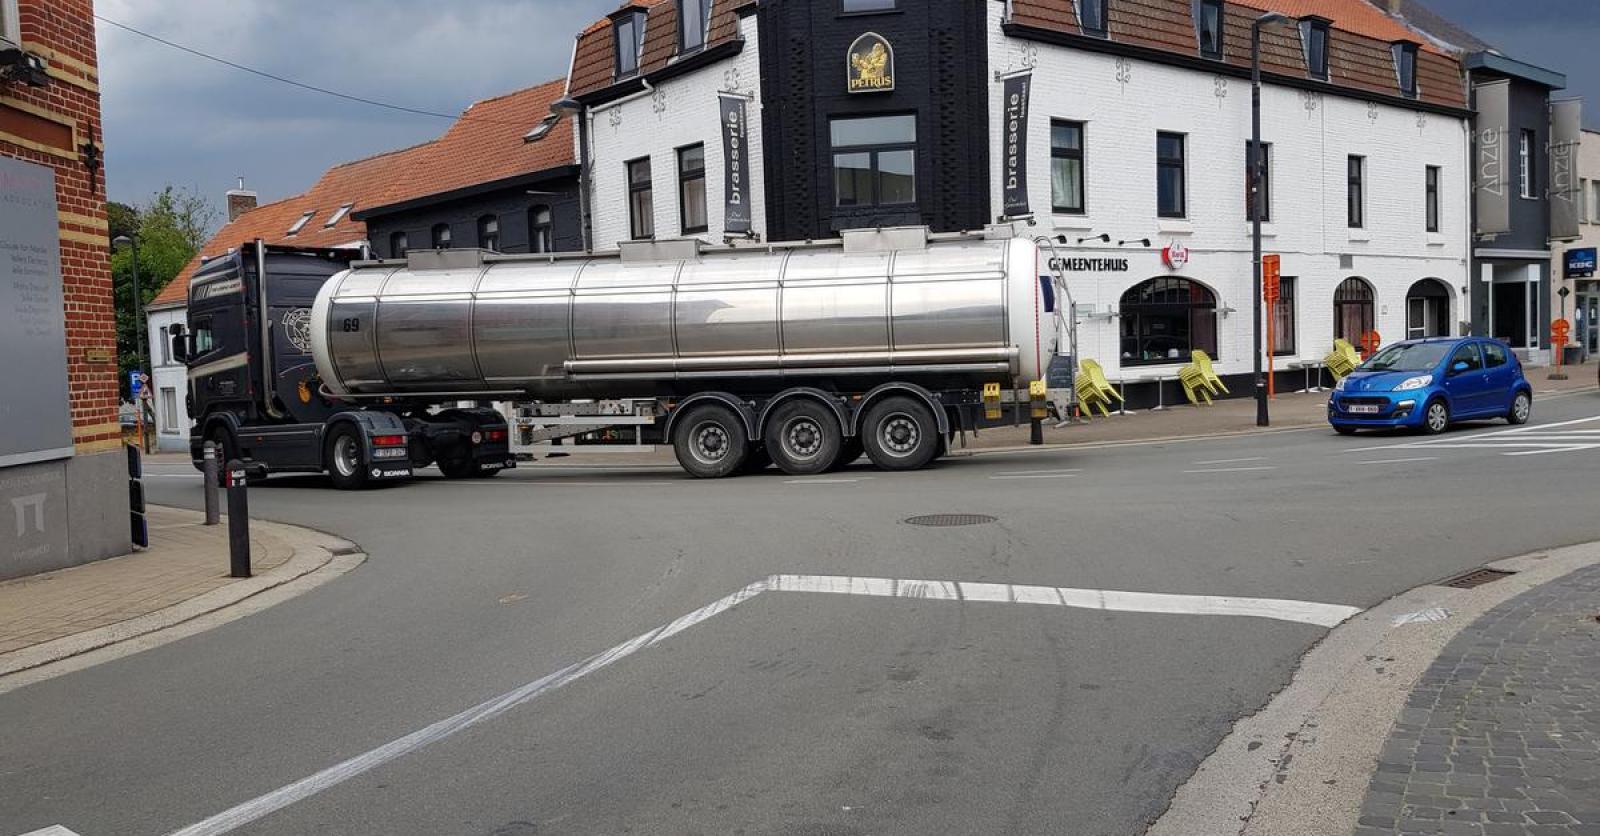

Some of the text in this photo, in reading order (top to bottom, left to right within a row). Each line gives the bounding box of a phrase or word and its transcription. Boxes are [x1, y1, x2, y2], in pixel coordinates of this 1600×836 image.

[851, 76, 892, 90] PETRUS
[1006, 92, 1019, 190] brasserie
[727, 110, 741, 205] brasserie
[1048, 257, 1129, 272] GEMEENTEHUIS
[343, 318, 360, 332] 69
